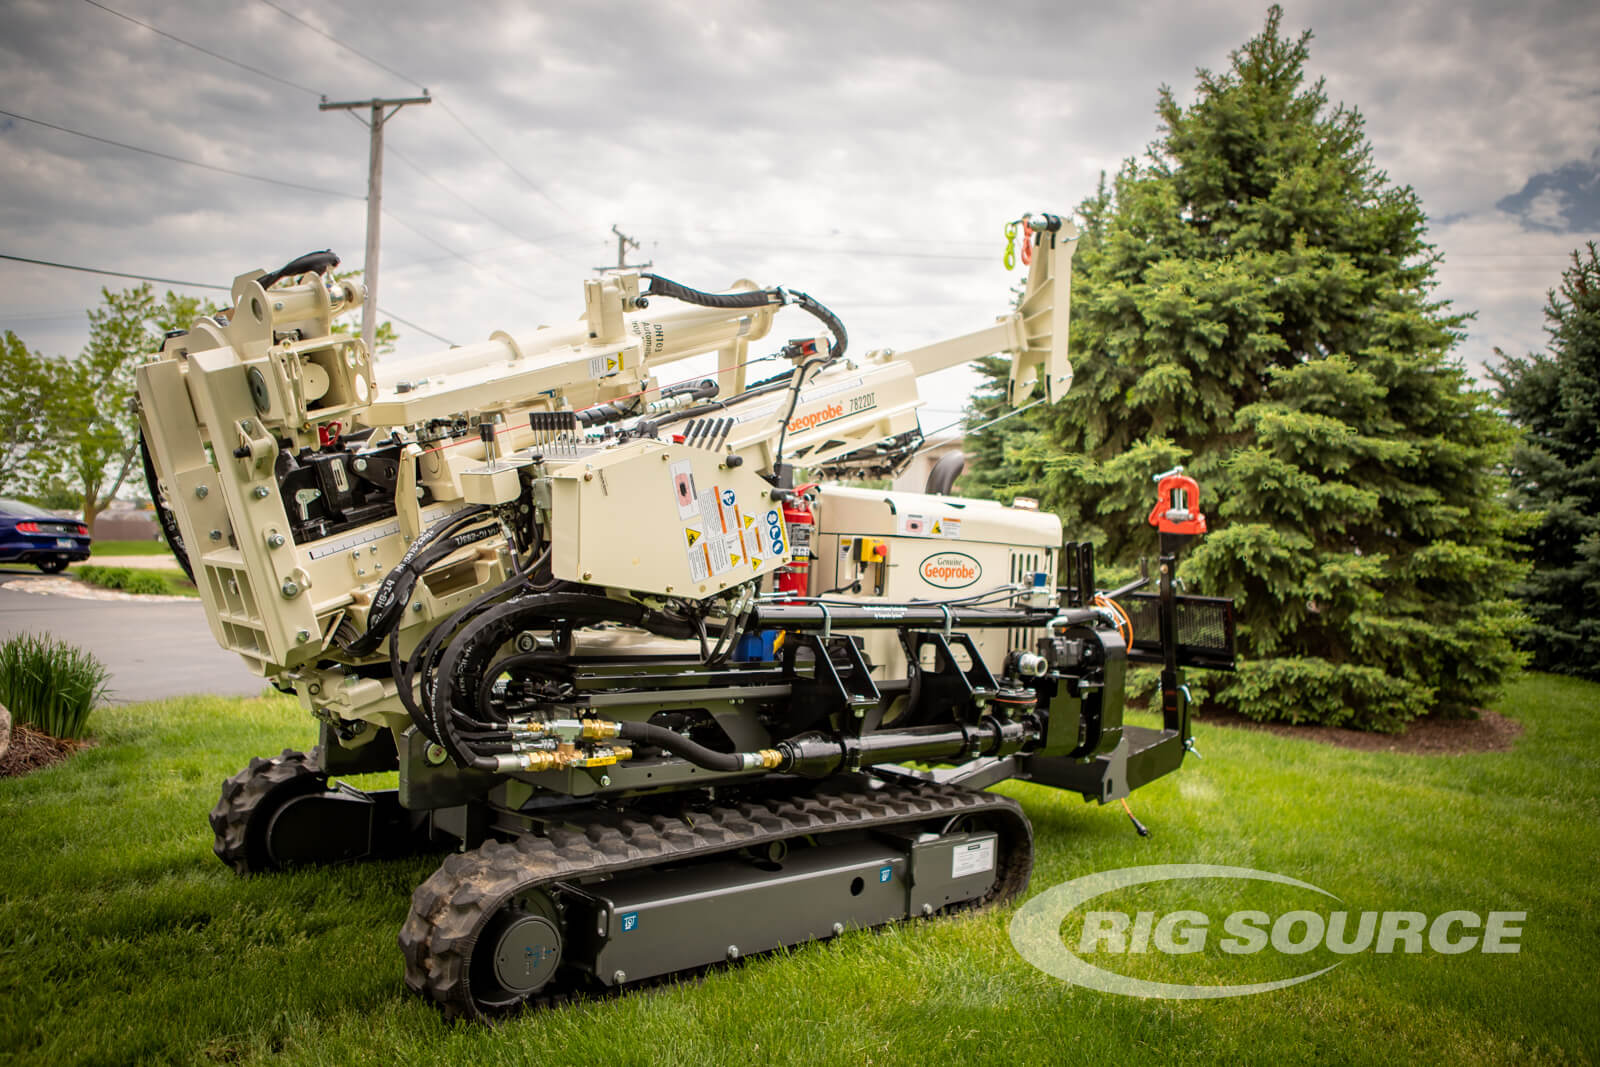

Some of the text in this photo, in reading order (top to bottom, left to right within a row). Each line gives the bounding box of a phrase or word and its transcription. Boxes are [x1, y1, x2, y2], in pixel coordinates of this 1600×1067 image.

[787, 392, 876, 432] Geoprobe 7822DT
[925, 562, 975, 582] Geoprobe
